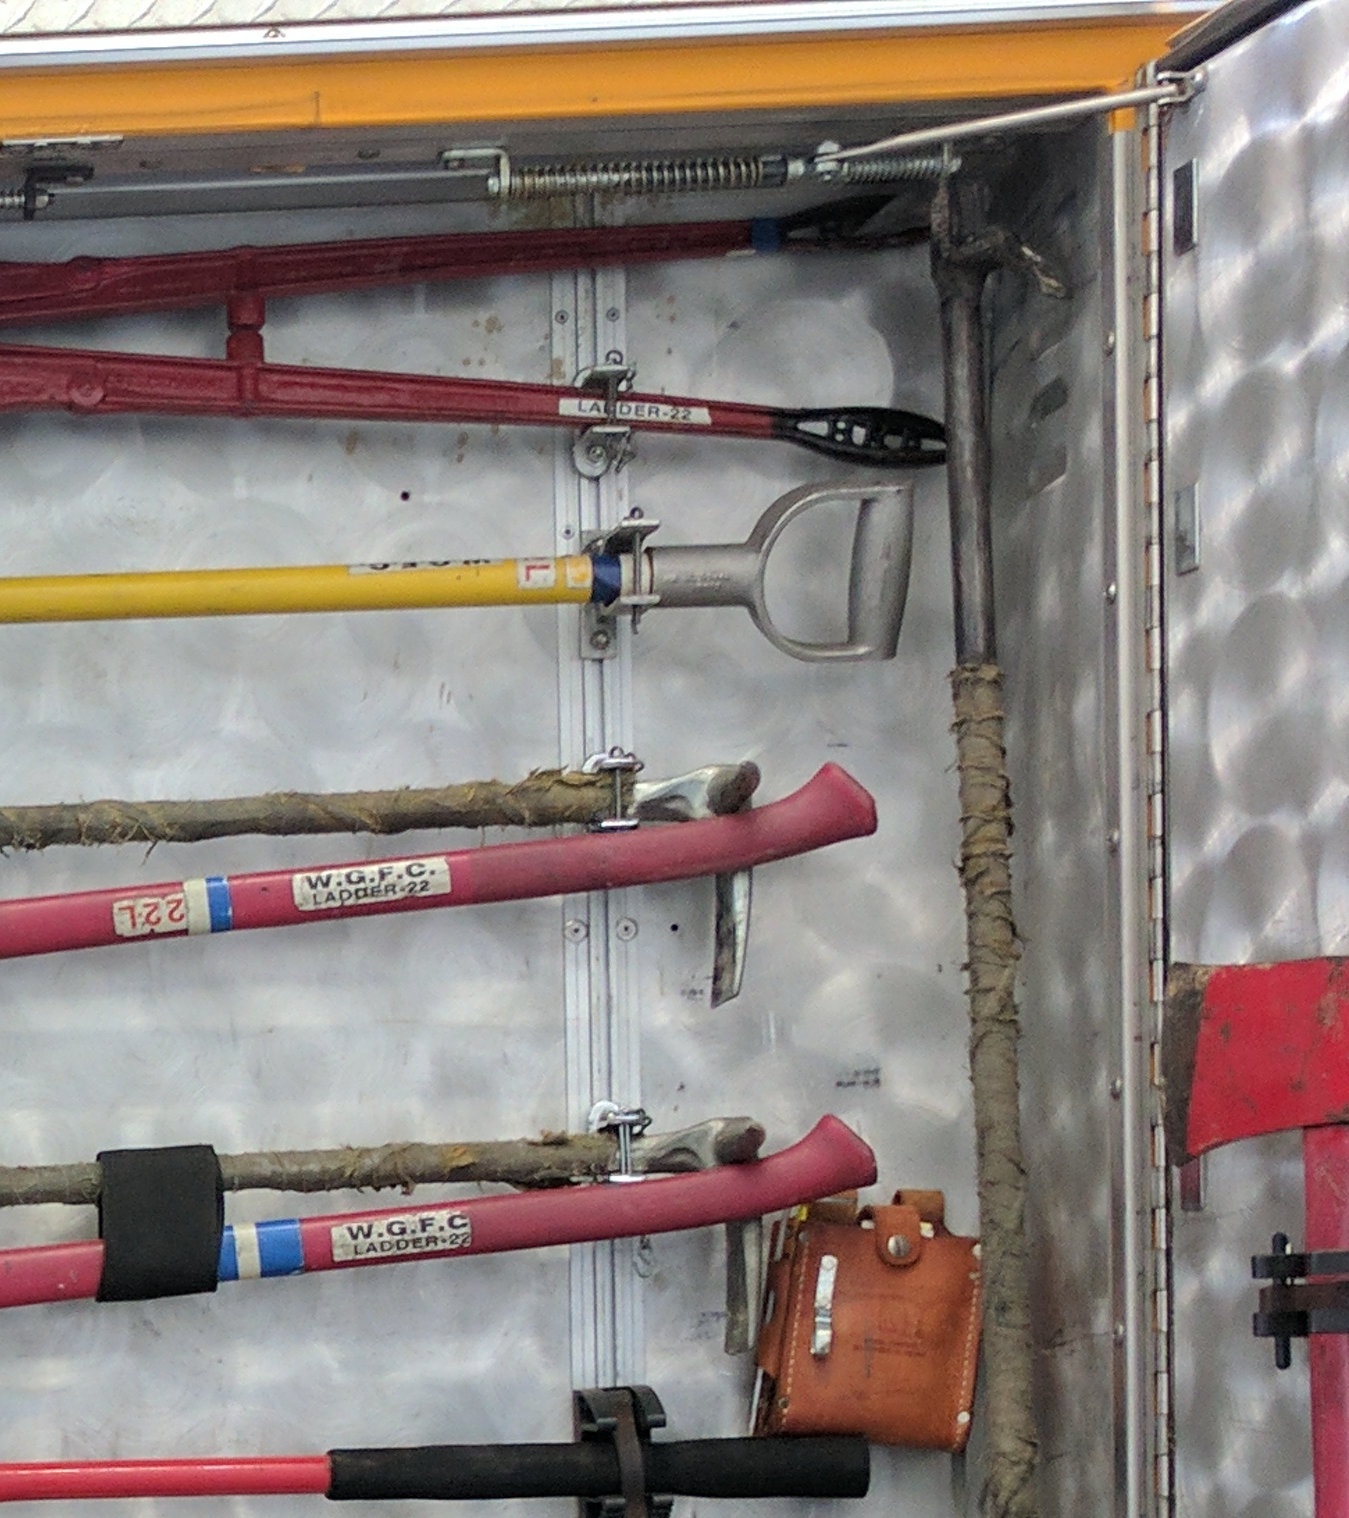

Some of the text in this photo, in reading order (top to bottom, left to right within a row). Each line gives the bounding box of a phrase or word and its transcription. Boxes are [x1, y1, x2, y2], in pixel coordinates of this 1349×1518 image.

[577, 399, 691, 422] LADER-22
[306, 862, 436, 890] W.G.F.C.
[312, 880, 430, 906] LADDER-22
[354, 1232, 470, 1256] LADDER-22
